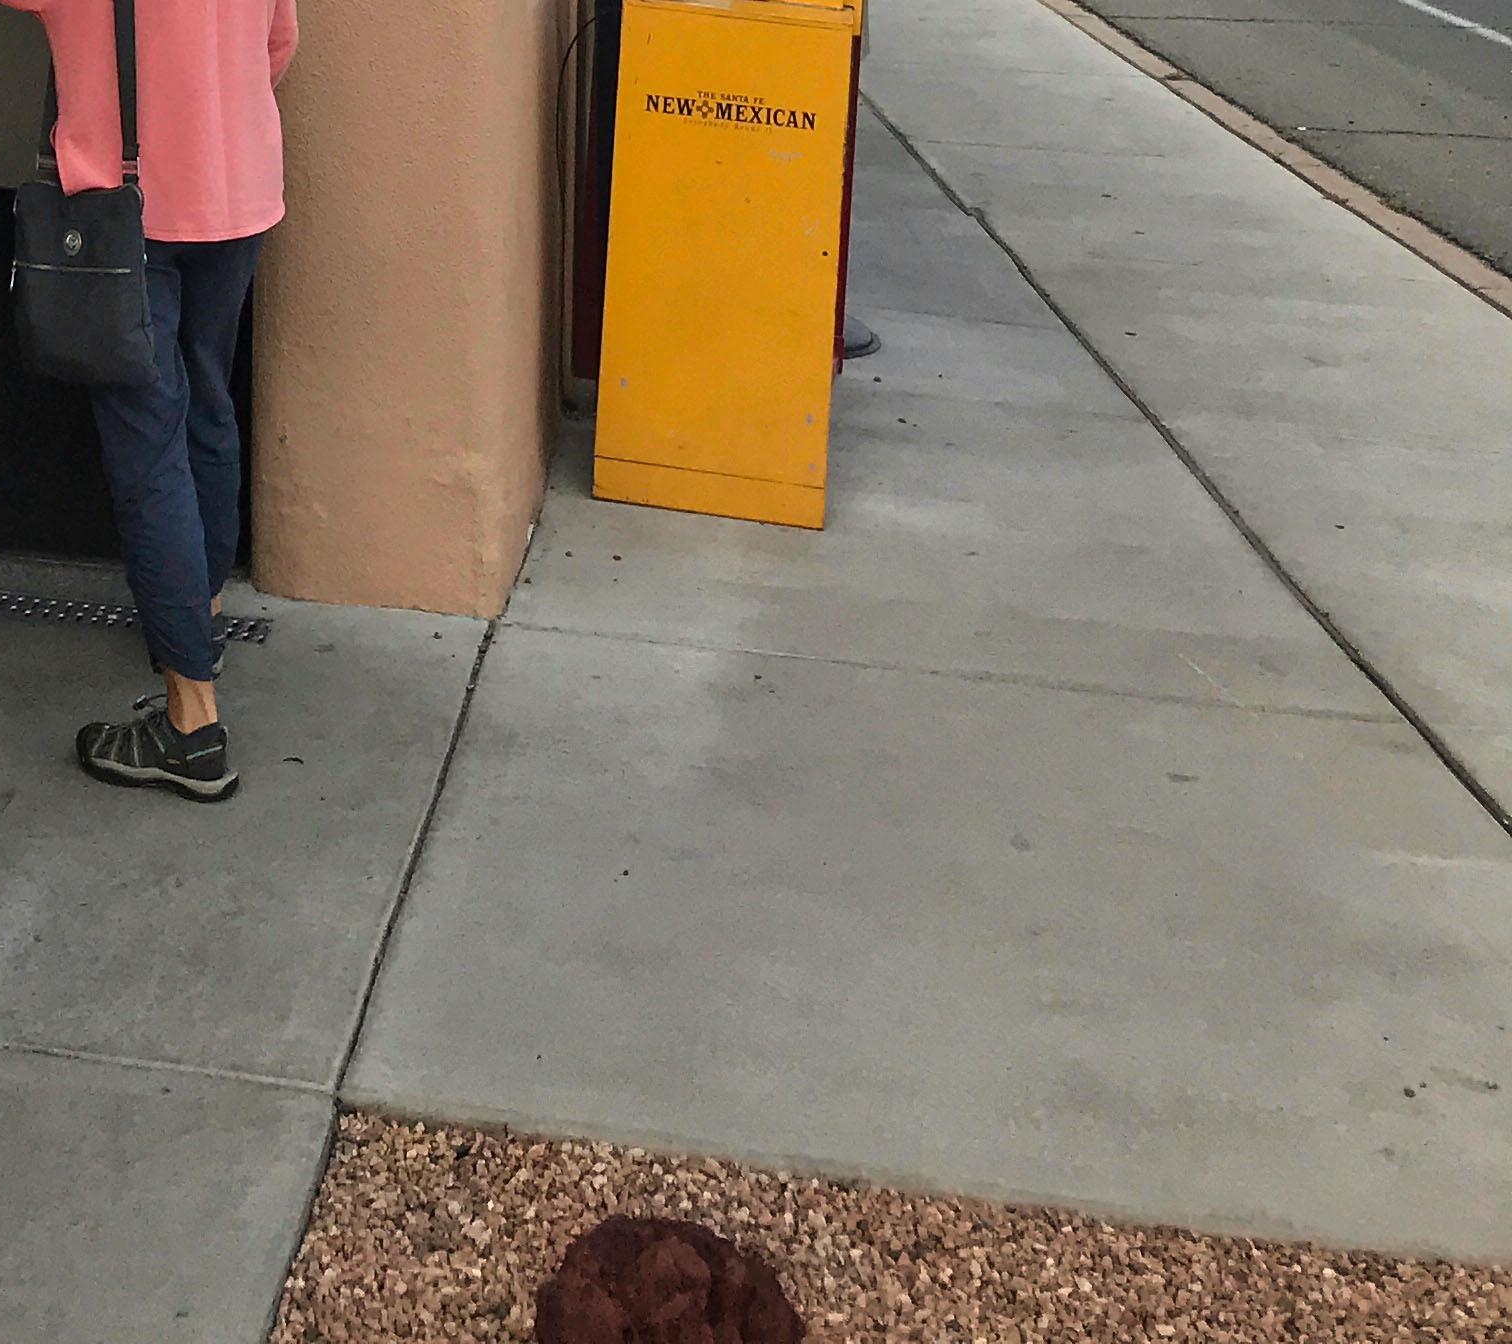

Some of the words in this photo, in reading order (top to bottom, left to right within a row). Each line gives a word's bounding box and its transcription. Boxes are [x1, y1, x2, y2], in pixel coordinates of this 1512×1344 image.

[697, 90, 716, 100] THE
[720, 93, 749, 103] SANTA
[753, 97, 764, 105] FE
[645, 94, 696, 116] NEW
[714, 101, 816, 131] MEXICAN
